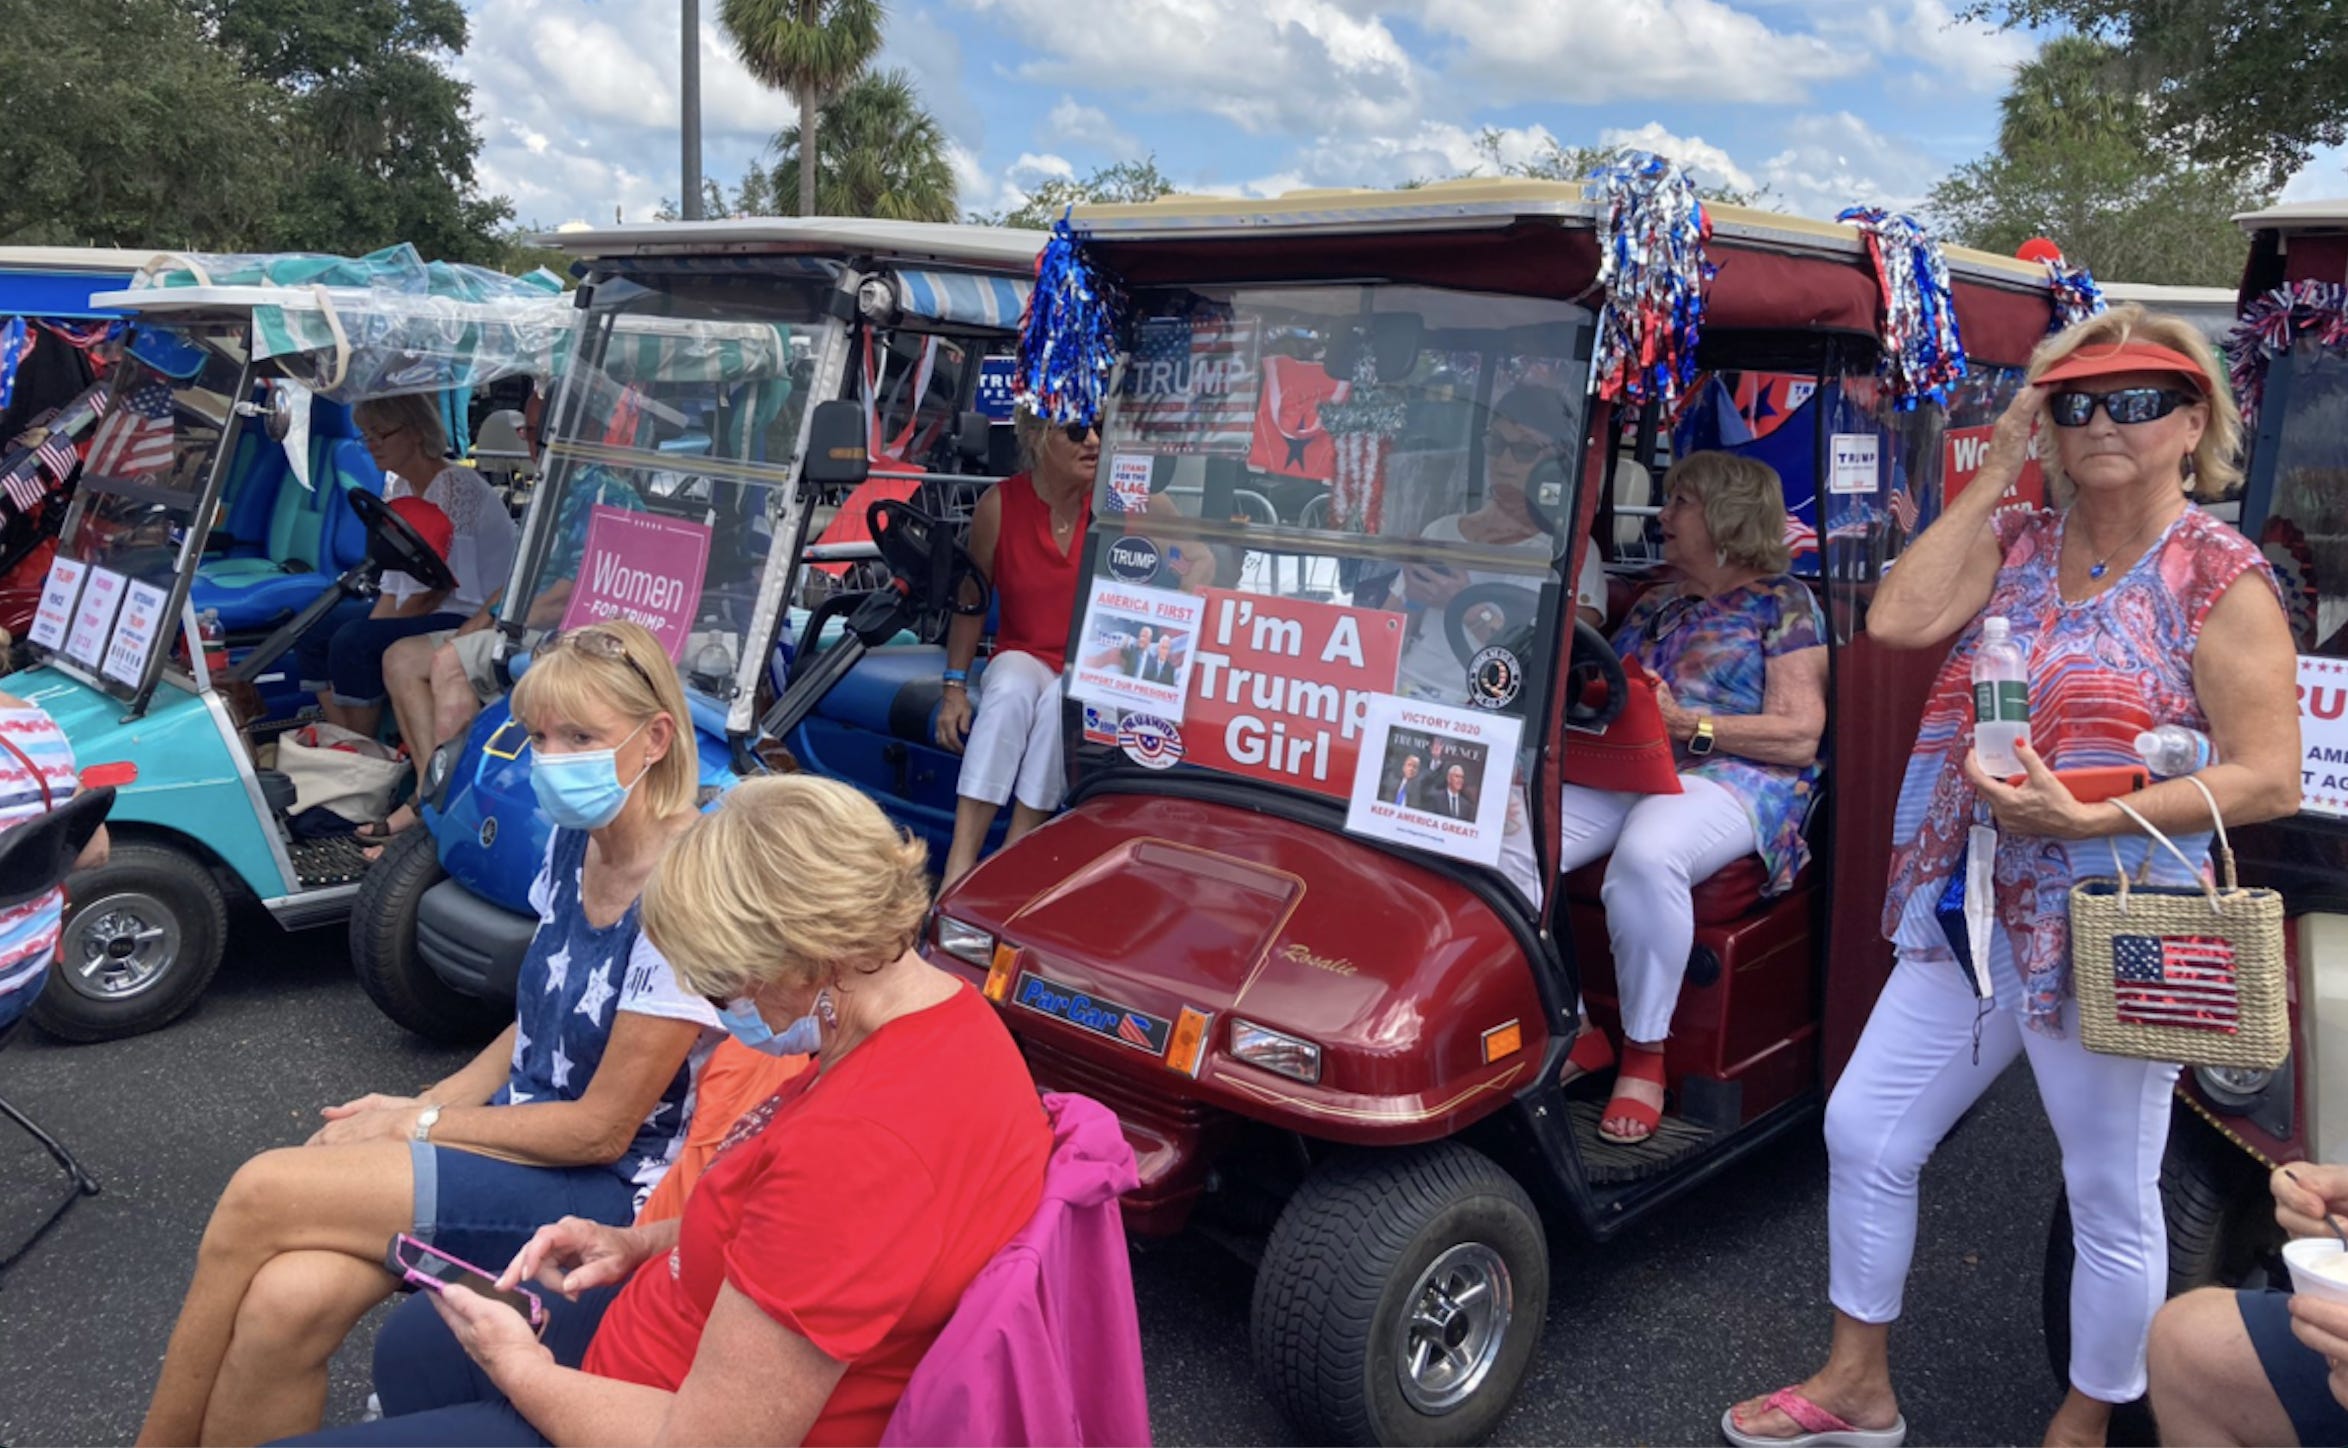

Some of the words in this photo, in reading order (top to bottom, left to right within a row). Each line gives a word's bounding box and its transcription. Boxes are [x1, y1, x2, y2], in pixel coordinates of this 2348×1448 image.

[980, 374, 1016, 388] TRU
[1132, 355, 1246, 396] TRUMP
[1122, 464, 1147, 473] STAND
[1132, 474, 1146, 482] THE
[1115, 481, 1145, 496] FLAG
[1113, 547, 1156, 569] TRUMP
[592, 549, 684, 614] Women
[1097, 592, 1149, 611] AMERICA
[1156, 602, 1195, 620] FIRST
[1216, 599, 1303, 657] I'm
[1320, 614, 1365, 668] A
[1079, 671, 1114, 687] SUPPORT
[1114, 679, 1134, 692] OUR
[1134, 684, 1180, 704] PRESIDENT
[1195, 650, 1369, 740] Trump
[1402, 711, 1451, 729] VICTORY
[1453, 721, 1481, 736] 2020
[1224, 715, 1331, 781] Girl
[1393, 733, 1430, 750] TRUMP
[1370, 804, 1396, 819] KEEP
[1396, 811, 1439, 830] AMERICA
[1441, 823, 1479, 839] GREAT!
[1280, 944, 1358, 977] Rosalie
